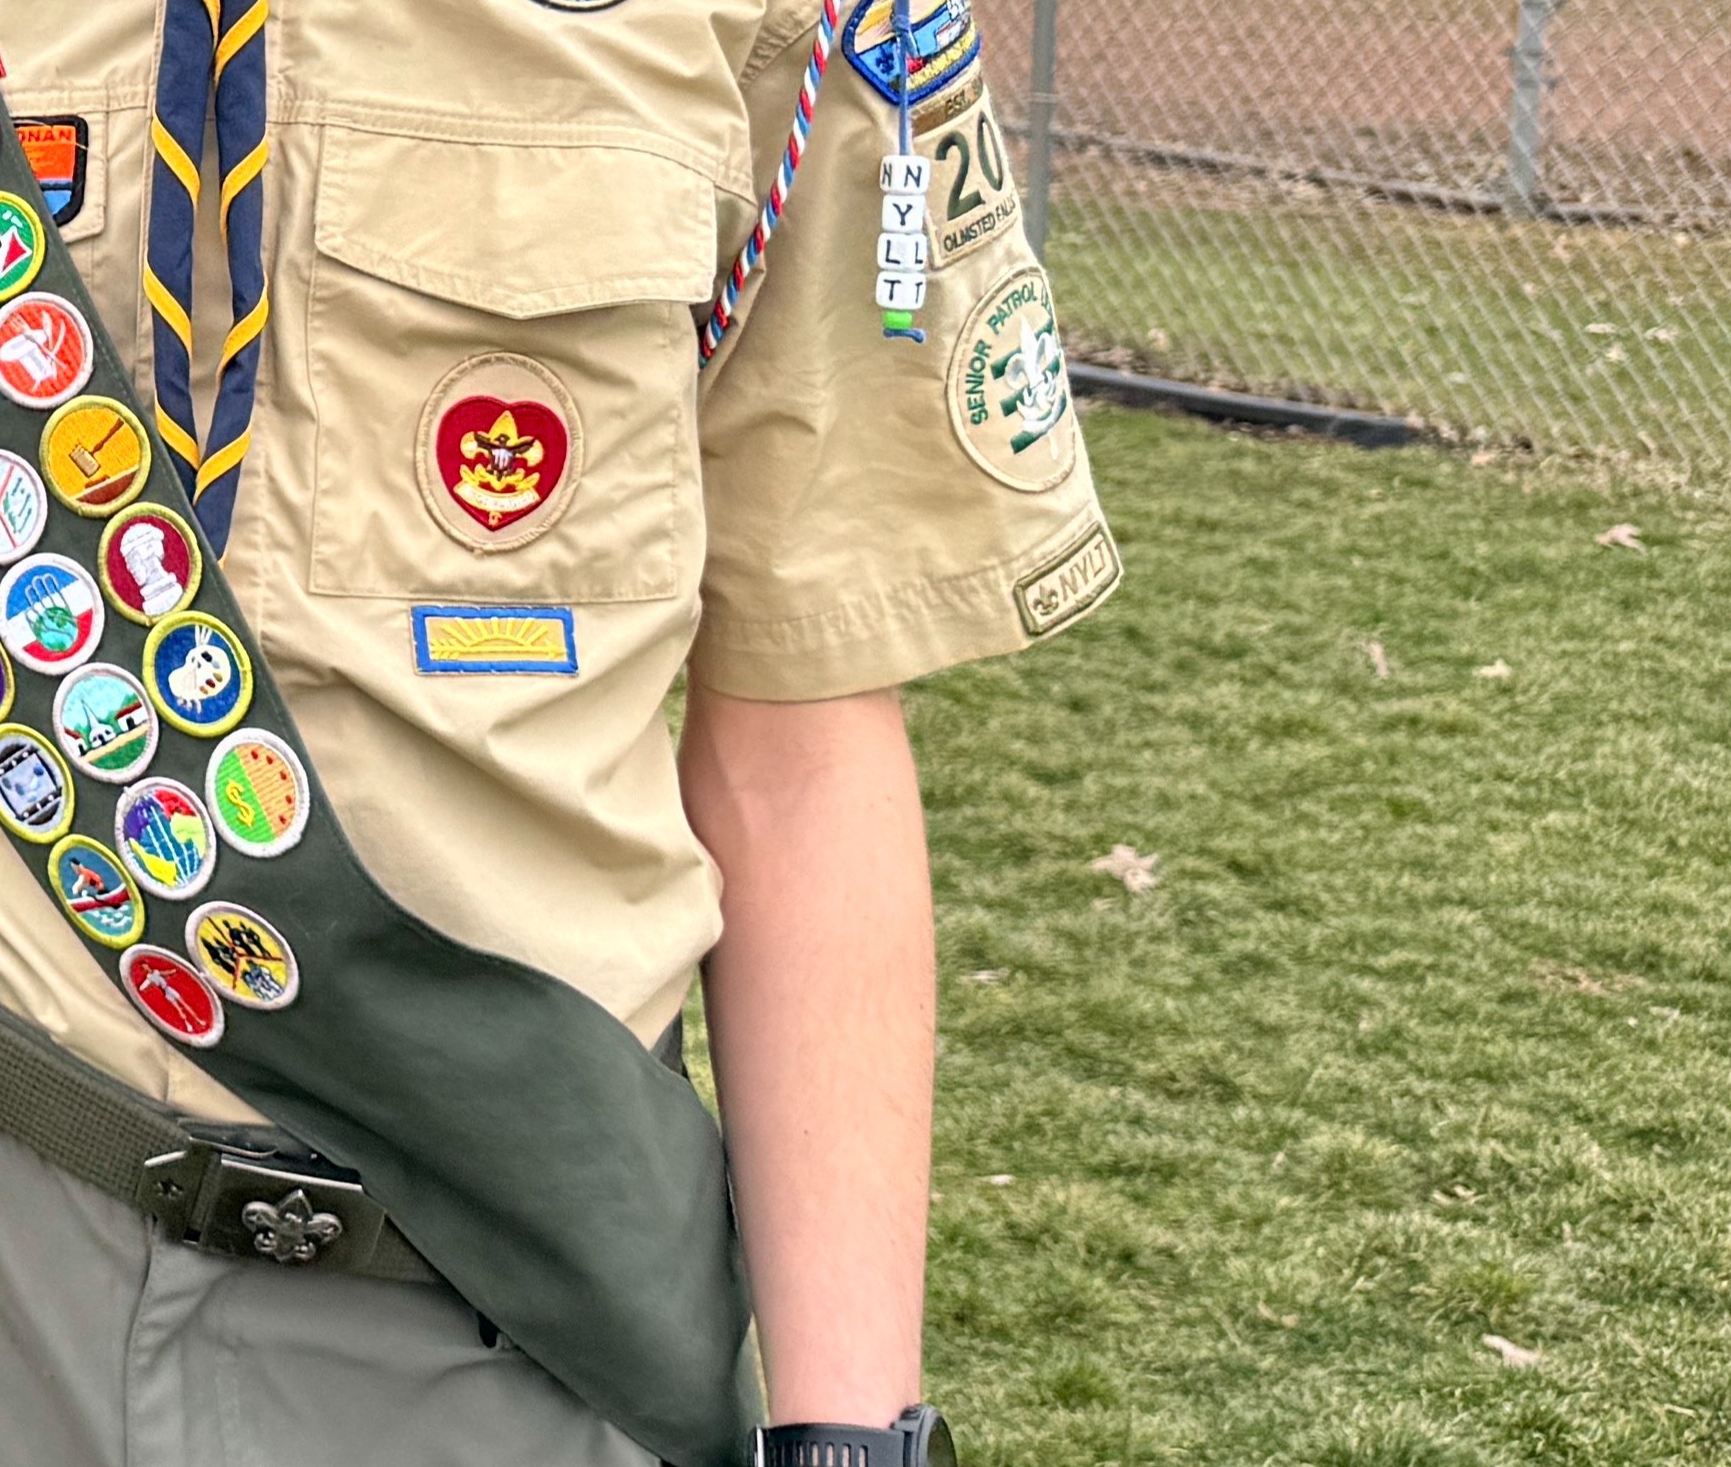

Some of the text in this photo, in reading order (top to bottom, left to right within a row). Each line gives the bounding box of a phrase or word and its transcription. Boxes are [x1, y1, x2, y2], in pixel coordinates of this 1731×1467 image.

[934, 110, 1004, 222] 20
[943, 211, 996, 253] OLMSTED
[964, 280, 1038, 426] SENIOR PATROL
[1058, 538, 1107, 603] NYLT
